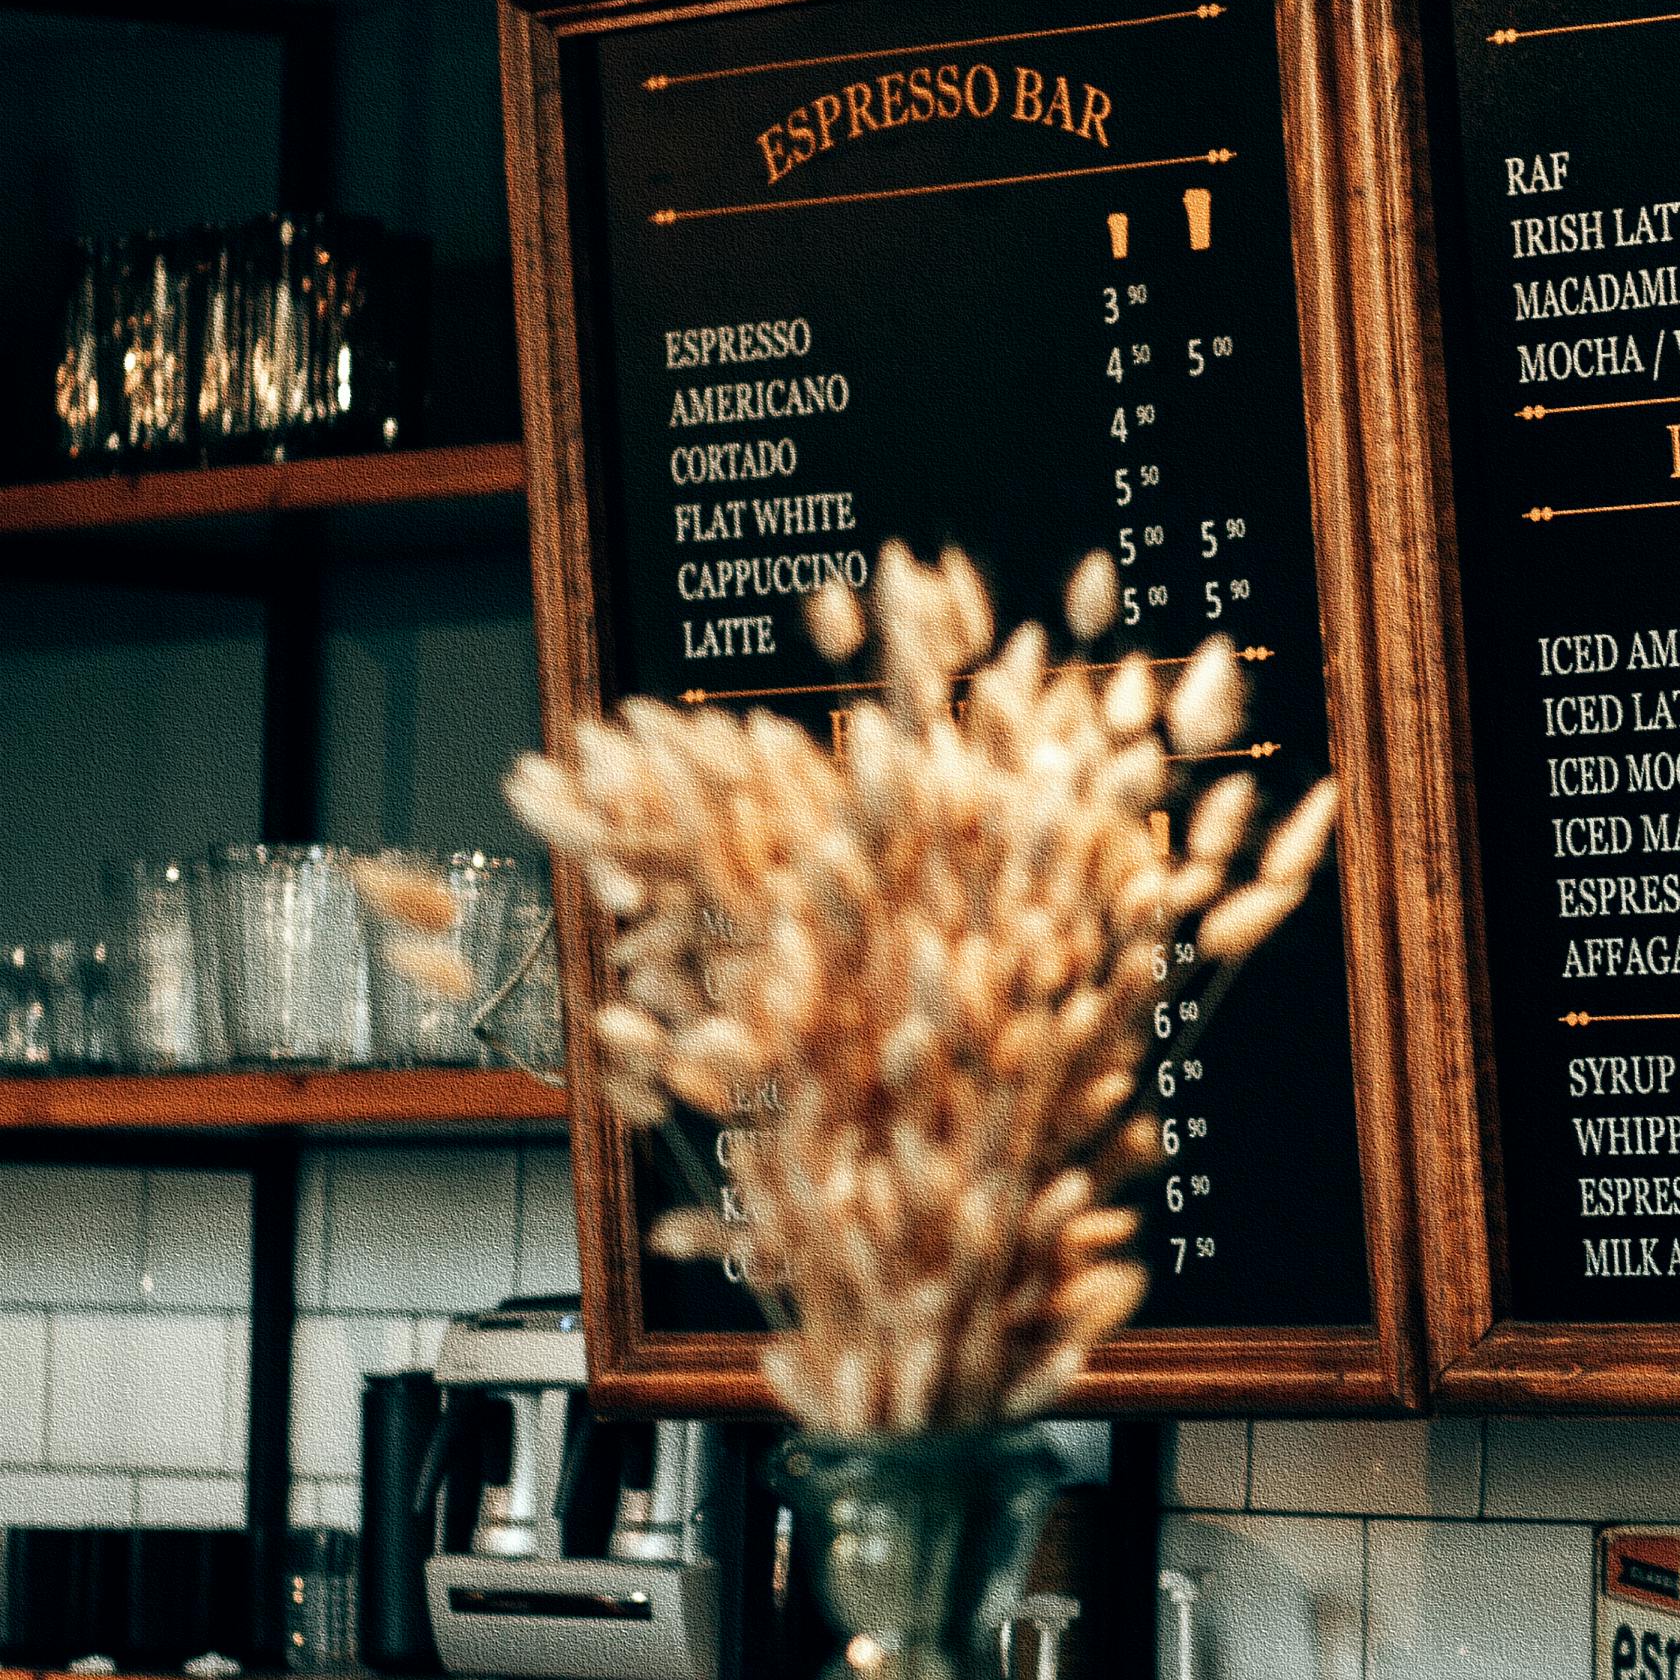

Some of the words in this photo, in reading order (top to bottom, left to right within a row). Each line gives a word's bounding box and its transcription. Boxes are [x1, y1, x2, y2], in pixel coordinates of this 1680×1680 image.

[757, 64, 999, 184] ESPRESSO
[1011, 68, 1114, 147] BAR
[1506, 152, 1569, 195] RAF
[1512, 211, 1604, 258] IRISH
[666, 319, 810, 368] ESPRESSO
[1518, 336, 1644, 383] MOCHA
[671, 375, 848, 426] AMERICANO
[671, 439, 796, 484] CORTADO
[676, 502, 745, 541] FLAT
[753, 493, 855, 534] WHITE
[678, 549, 868, 601] CAPPUCCINO
[684, 616, 775, 658] LATTE
[1539, 634, 1618, 675] ICED
[1544, 695, 1623, 735] ICED
[1549, 756, 1619, 796] ICED
[1553, 817, 1632, 856] ICED
[1569, 1056, 1675, 1096] SYRUP
[1584, 1238, 1661, 1276] MILK
